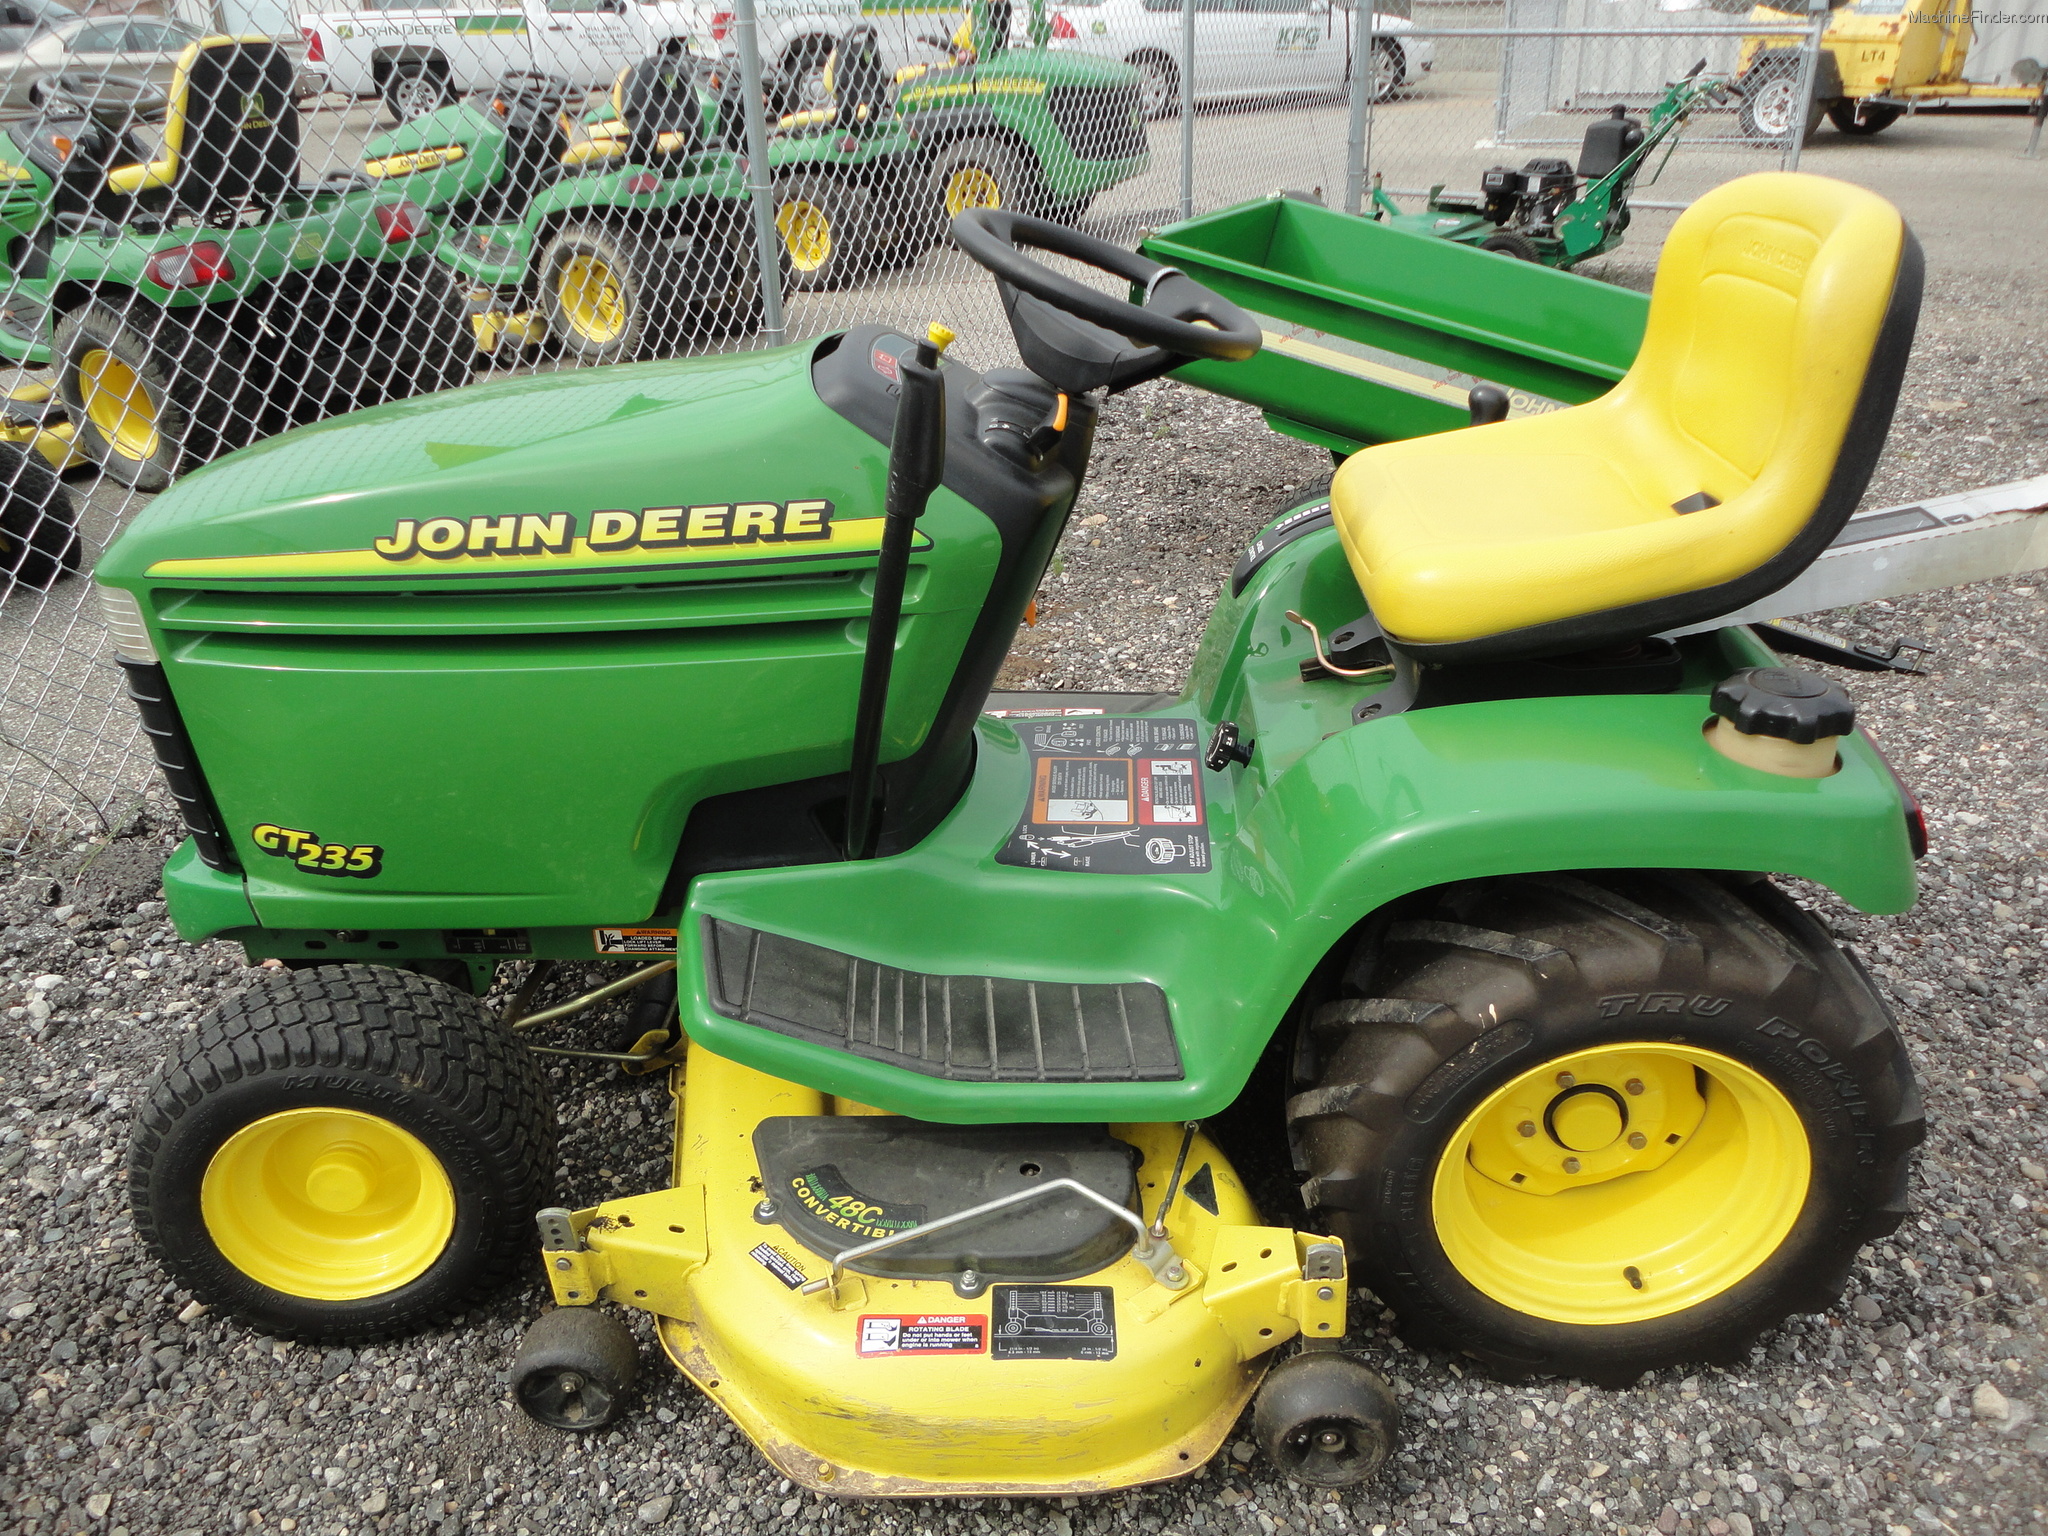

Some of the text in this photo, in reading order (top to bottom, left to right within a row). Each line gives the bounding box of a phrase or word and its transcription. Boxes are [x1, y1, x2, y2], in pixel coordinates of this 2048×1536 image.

[358, 24, 453, 37] JOHN DEERE
[1861, 50, 1885, 62] LT4
[374, 499, 834, 561] JOHN DEERE
[1140, 777, 1149, 797] DANGER
[1598, 991, 1733, 1018] TRU
[792, 1177, 896, 1239] CONVERTIB
[828, 1195, 884, 1224] 48C
[777, 1247, 807, 1272] CAUTION
[928, 1316, 966, 1324] DANGER
